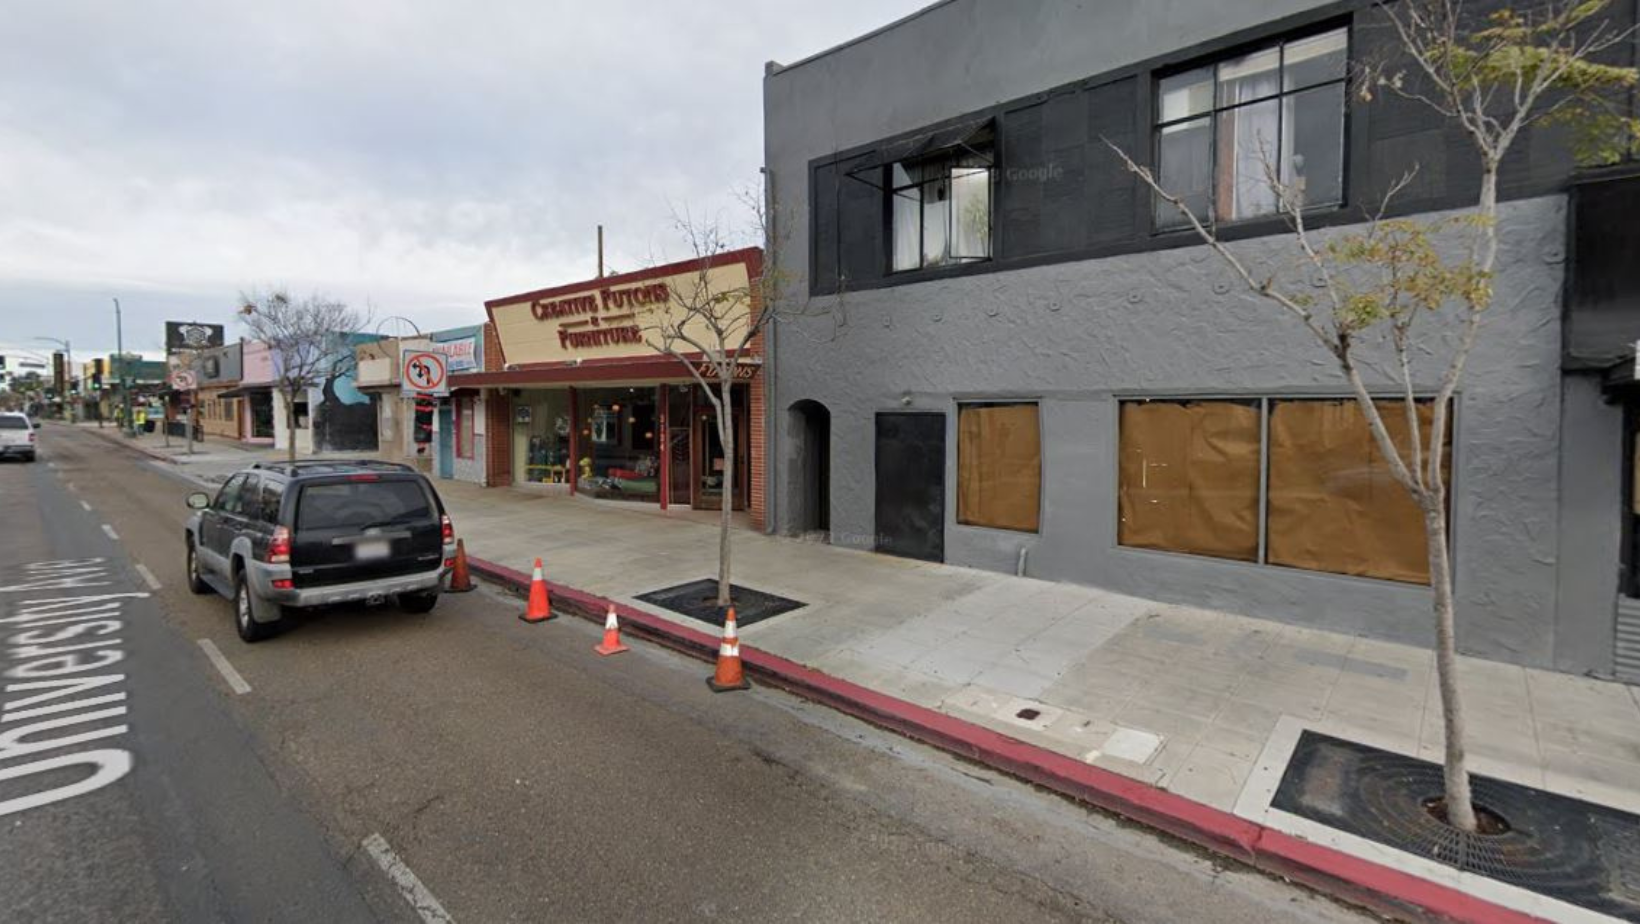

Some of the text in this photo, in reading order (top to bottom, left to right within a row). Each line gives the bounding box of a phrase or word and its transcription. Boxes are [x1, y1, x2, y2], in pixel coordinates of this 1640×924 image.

[530, 282, 671, 322] CREATIVE FUTONS
[557, 324, 644, 350] FURNITURE
[698, 361, 753, 380] FUNS
